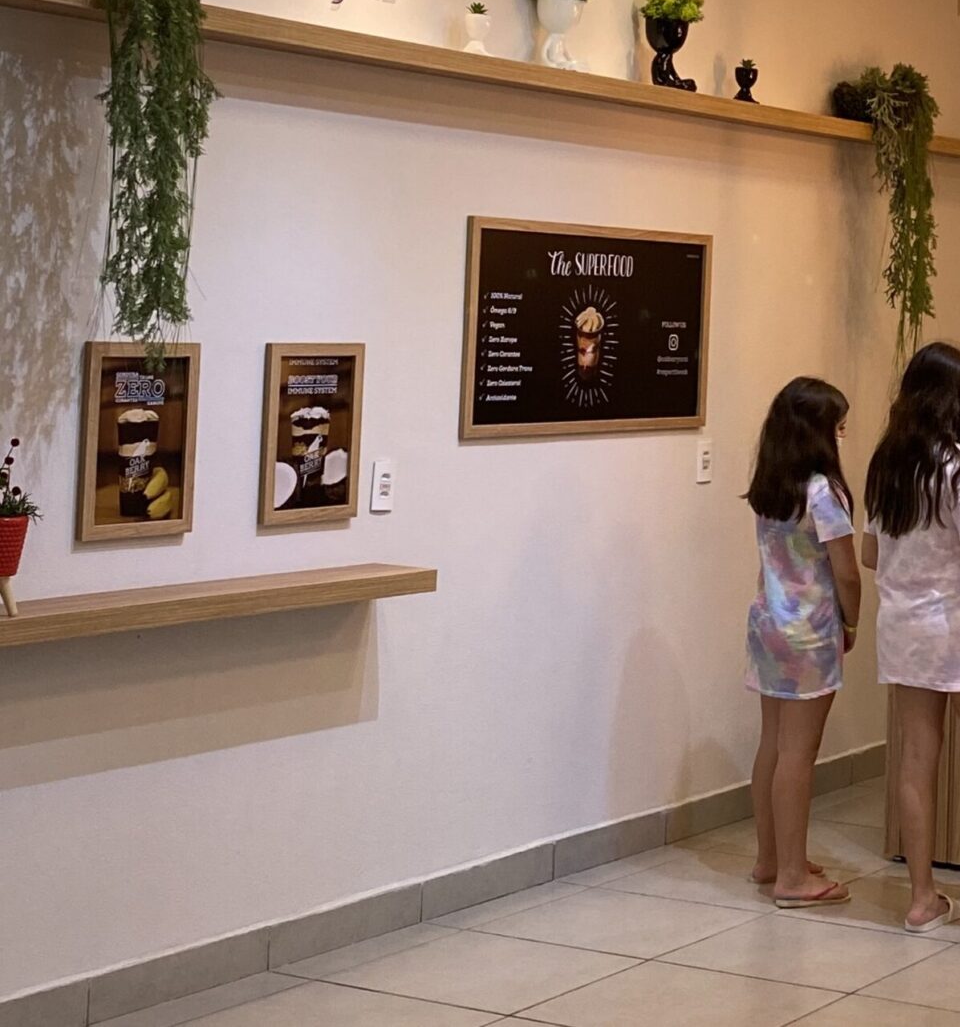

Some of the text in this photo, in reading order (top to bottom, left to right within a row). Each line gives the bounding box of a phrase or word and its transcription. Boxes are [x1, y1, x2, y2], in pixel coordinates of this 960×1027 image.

[547, 251, 634, 277] The SUPERFOOD
[114, 379, 165, 398] ZERO
[125, 460, 150, 477] BERRY
[129, 454, 146, 466] OAK
